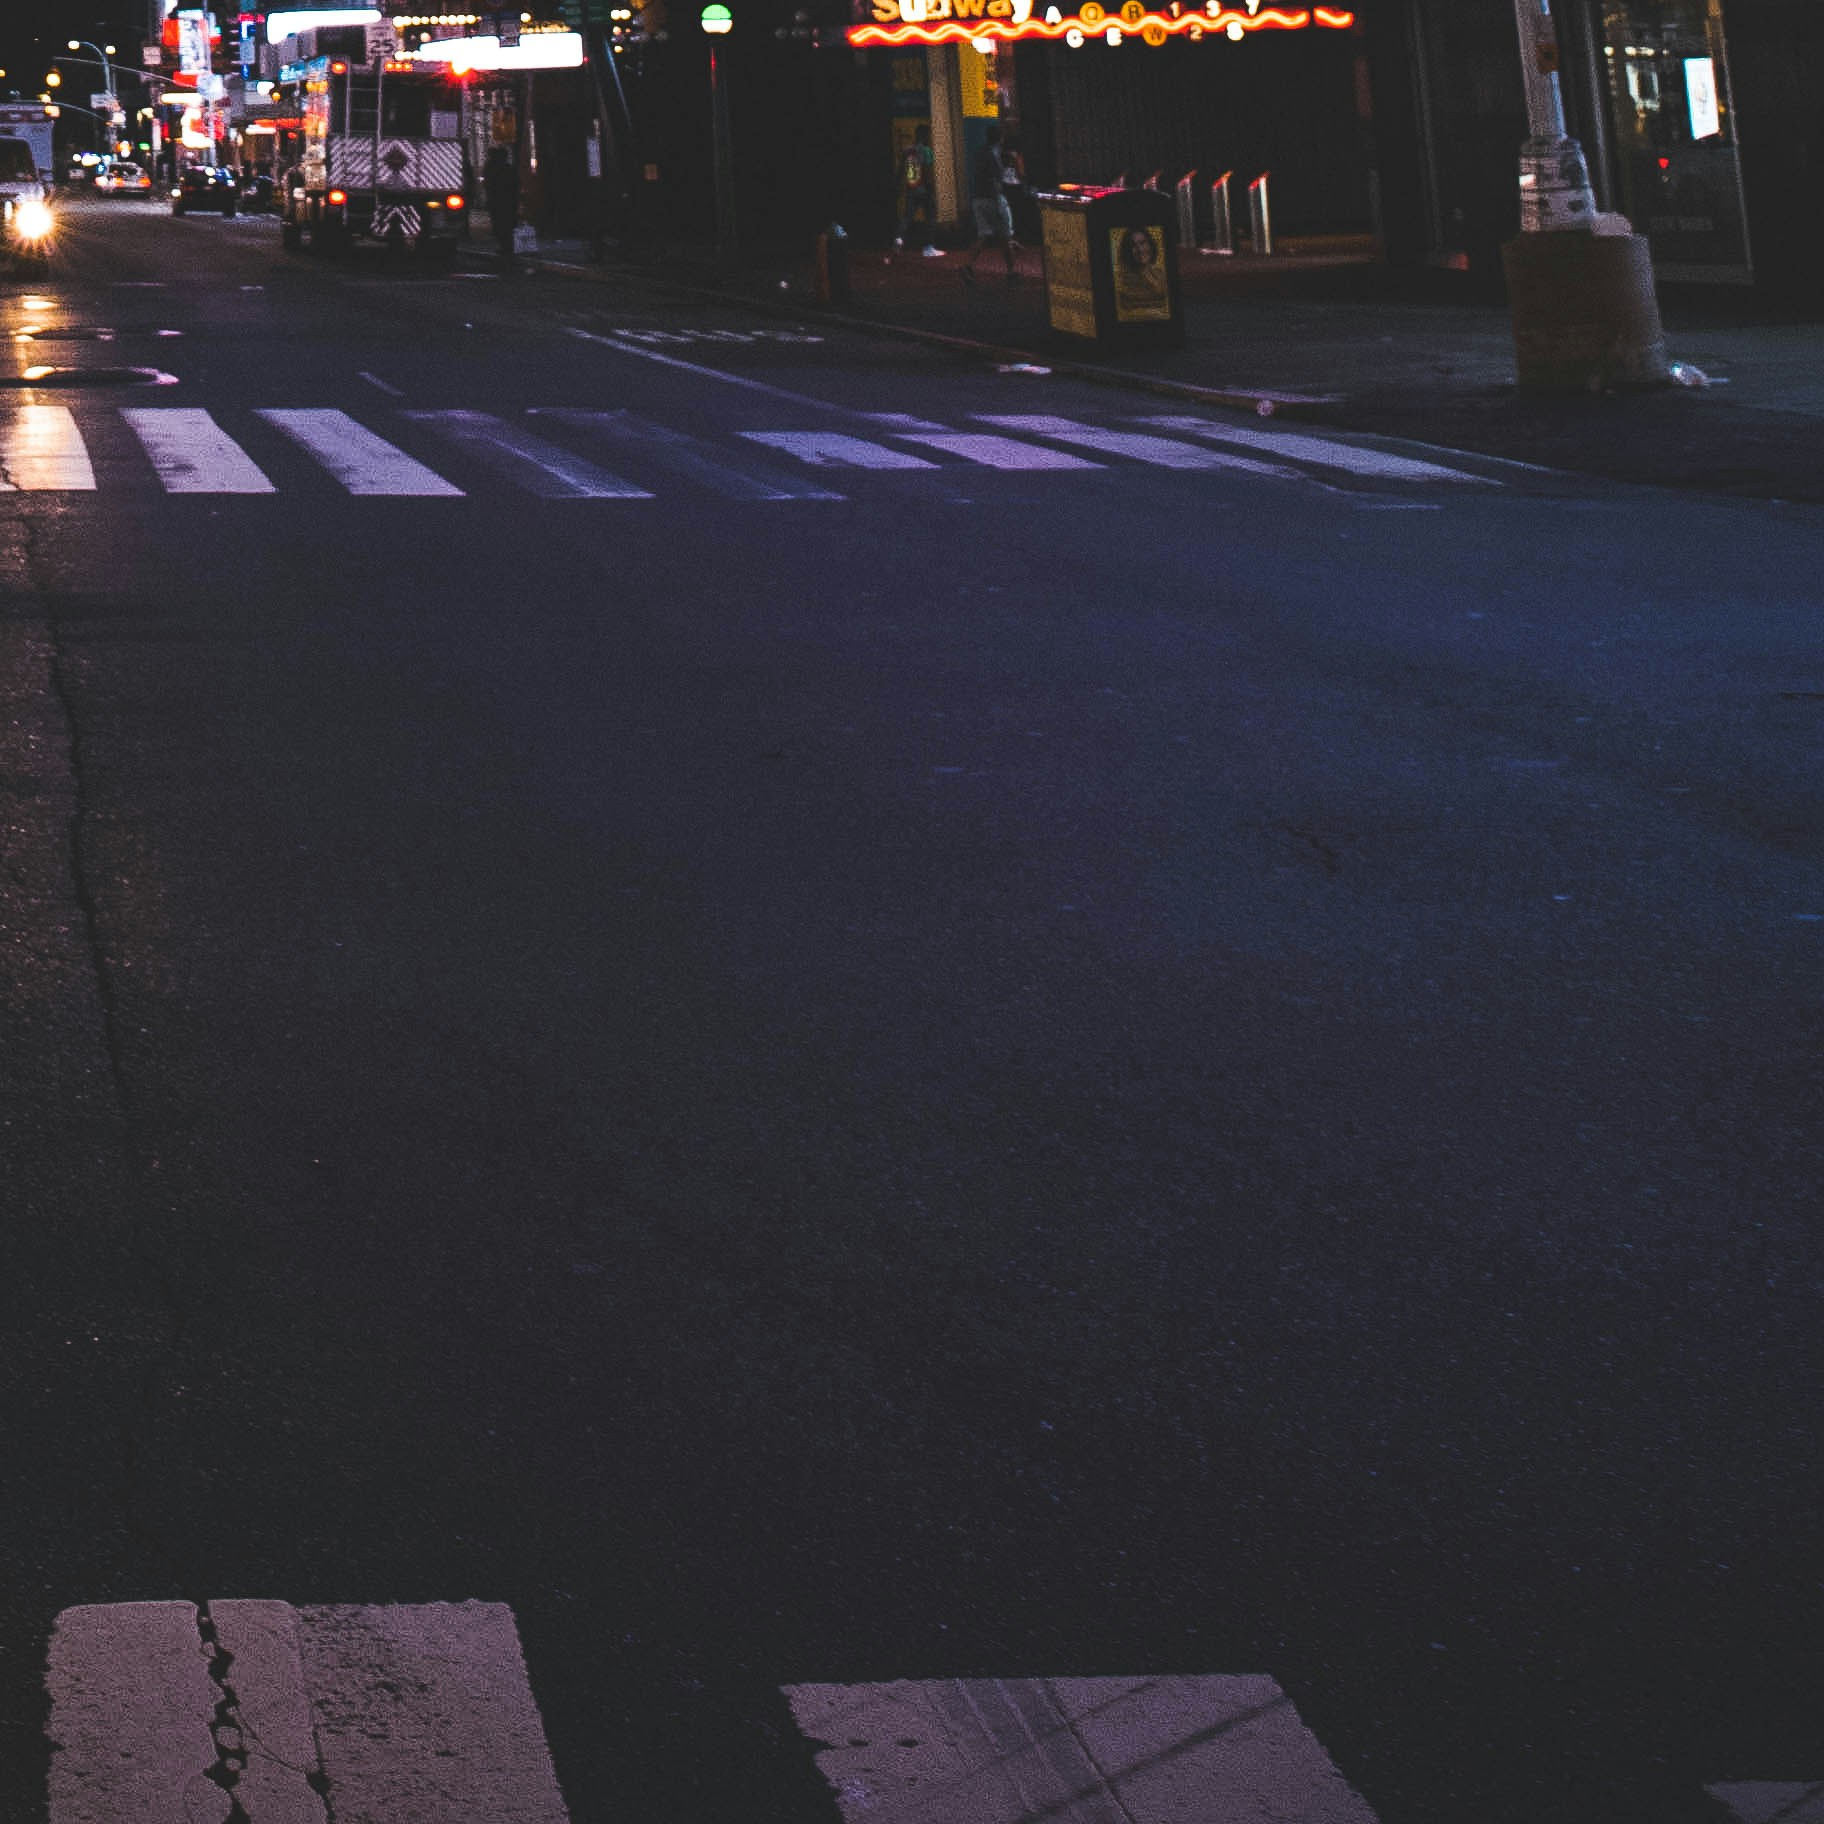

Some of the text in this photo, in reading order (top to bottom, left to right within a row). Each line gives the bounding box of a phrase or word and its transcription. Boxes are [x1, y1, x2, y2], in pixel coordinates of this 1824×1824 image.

[1169, 1, 1181, 19] 1
[1206, 0, 1222, 19] 3
[1189, 25, 1204, 42] 2
